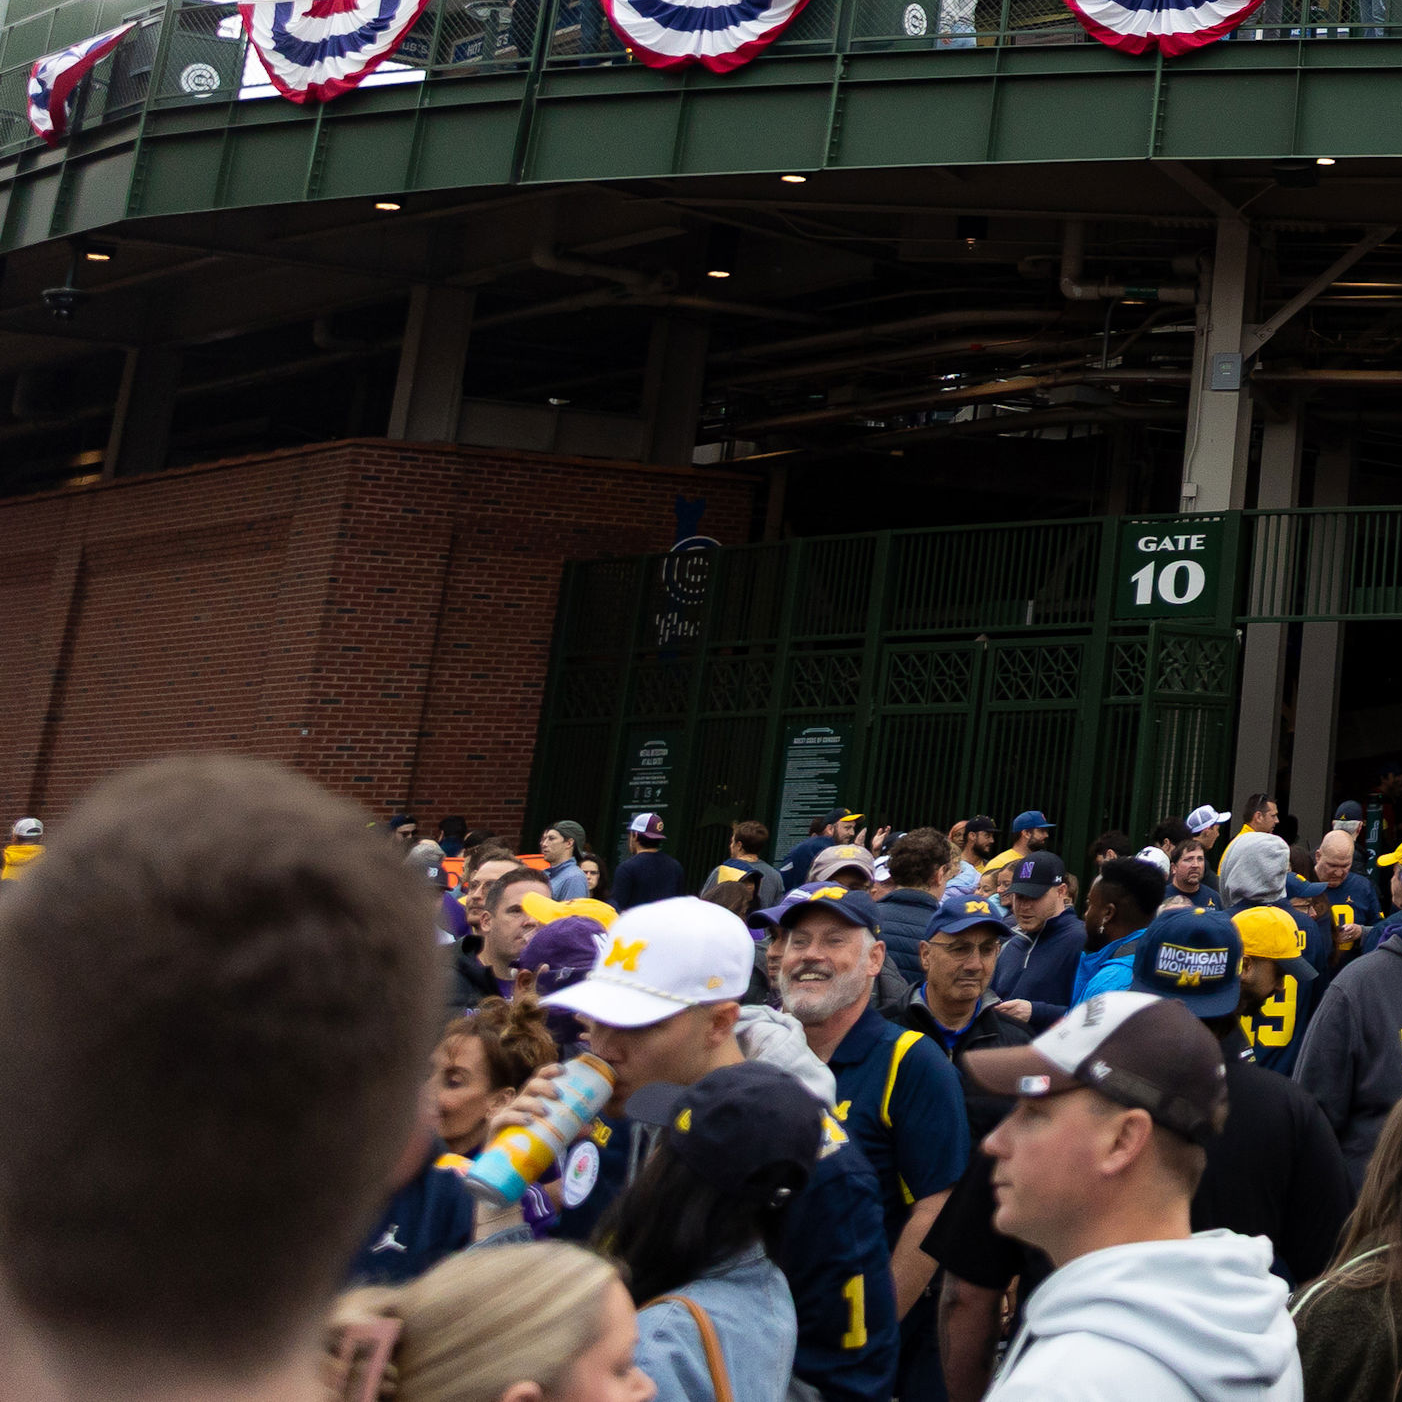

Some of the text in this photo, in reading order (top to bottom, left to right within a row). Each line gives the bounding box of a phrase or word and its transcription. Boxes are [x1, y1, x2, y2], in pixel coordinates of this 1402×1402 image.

[1137, 533, 1206, 552] GATE
[1130, 559, 1206, 605] 10
[1019, 861, 1035, 879] N
[964, 901, 991, 915] M
[604, 936, 650, 972] M
[1160, 945, 1229, 965] MICHIGAN
[842, 1274, 868, 1350] 1
